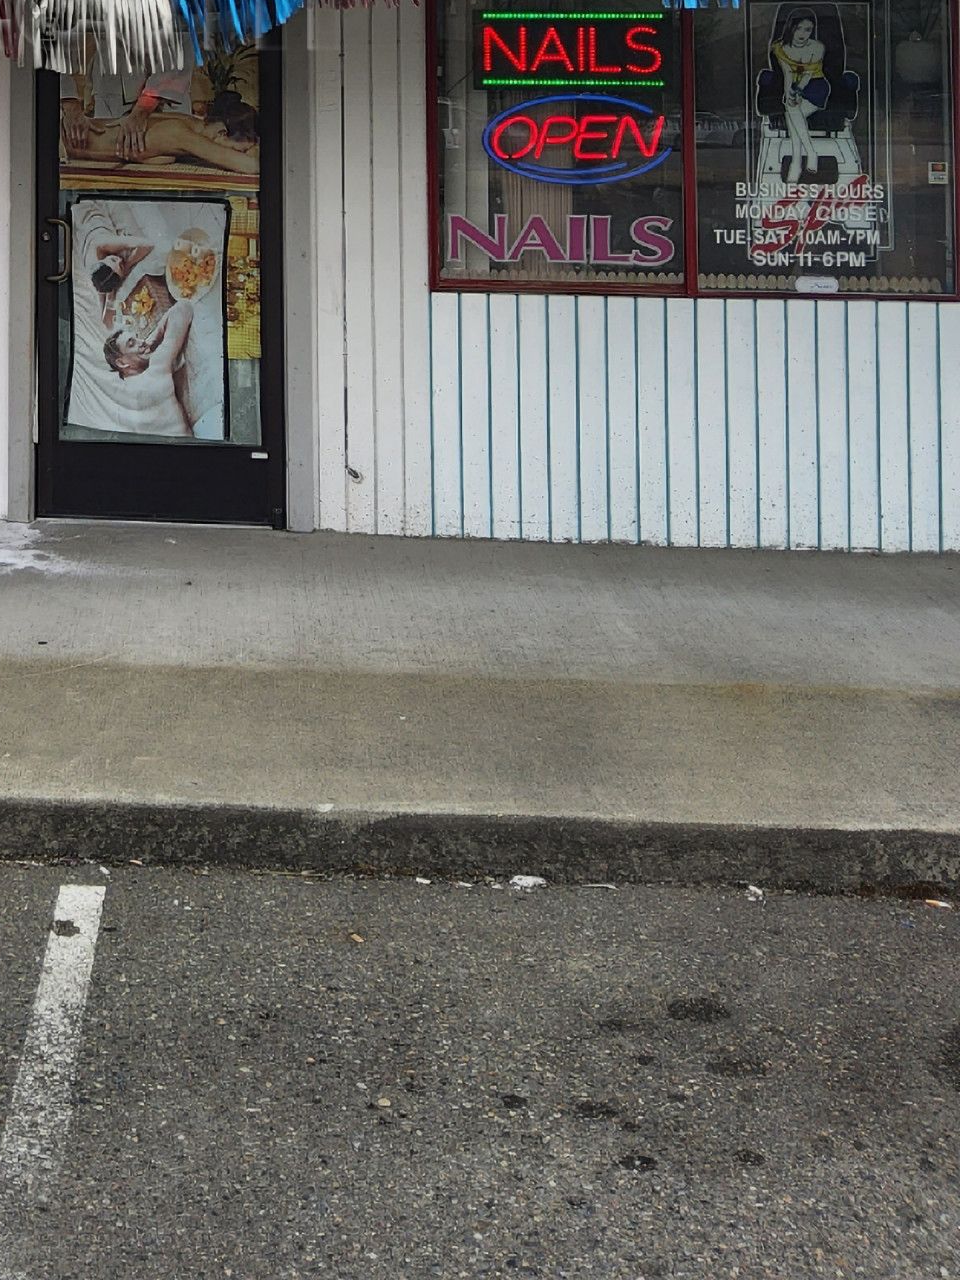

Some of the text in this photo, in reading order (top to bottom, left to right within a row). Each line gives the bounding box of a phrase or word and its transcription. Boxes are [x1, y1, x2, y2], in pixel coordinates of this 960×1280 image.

[482, 25, 662, 73] NAILS
[492, 114, 665, 158] OPEN
[735, 182, 884, 200] BUSINESS HOURS
[735, 204, 808, 220] MONDAY
[447, 213, 674, 266] NAILS
